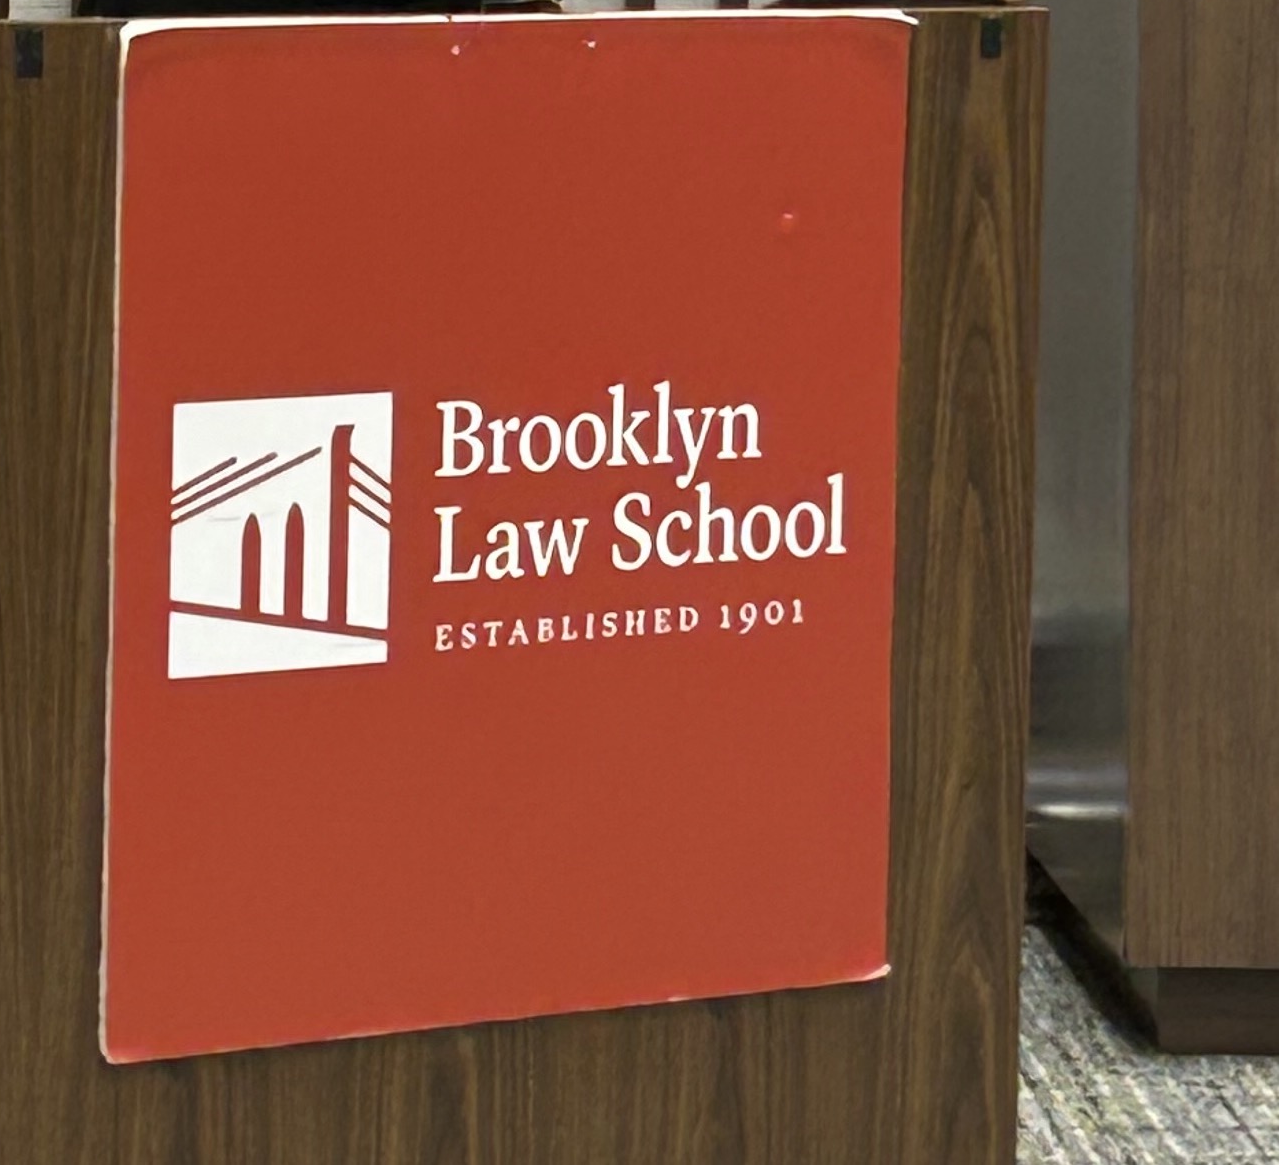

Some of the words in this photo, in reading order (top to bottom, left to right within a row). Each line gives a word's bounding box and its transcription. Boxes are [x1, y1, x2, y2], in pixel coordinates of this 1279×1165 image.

[434, 380, 763, 490] Brooklyn
[432, 505, 590, 583] Law
[611, 472, 847, 571] School
[435, 606, 699, 651] ESTABLISHED
[720, 599, 803, 635] 1901
